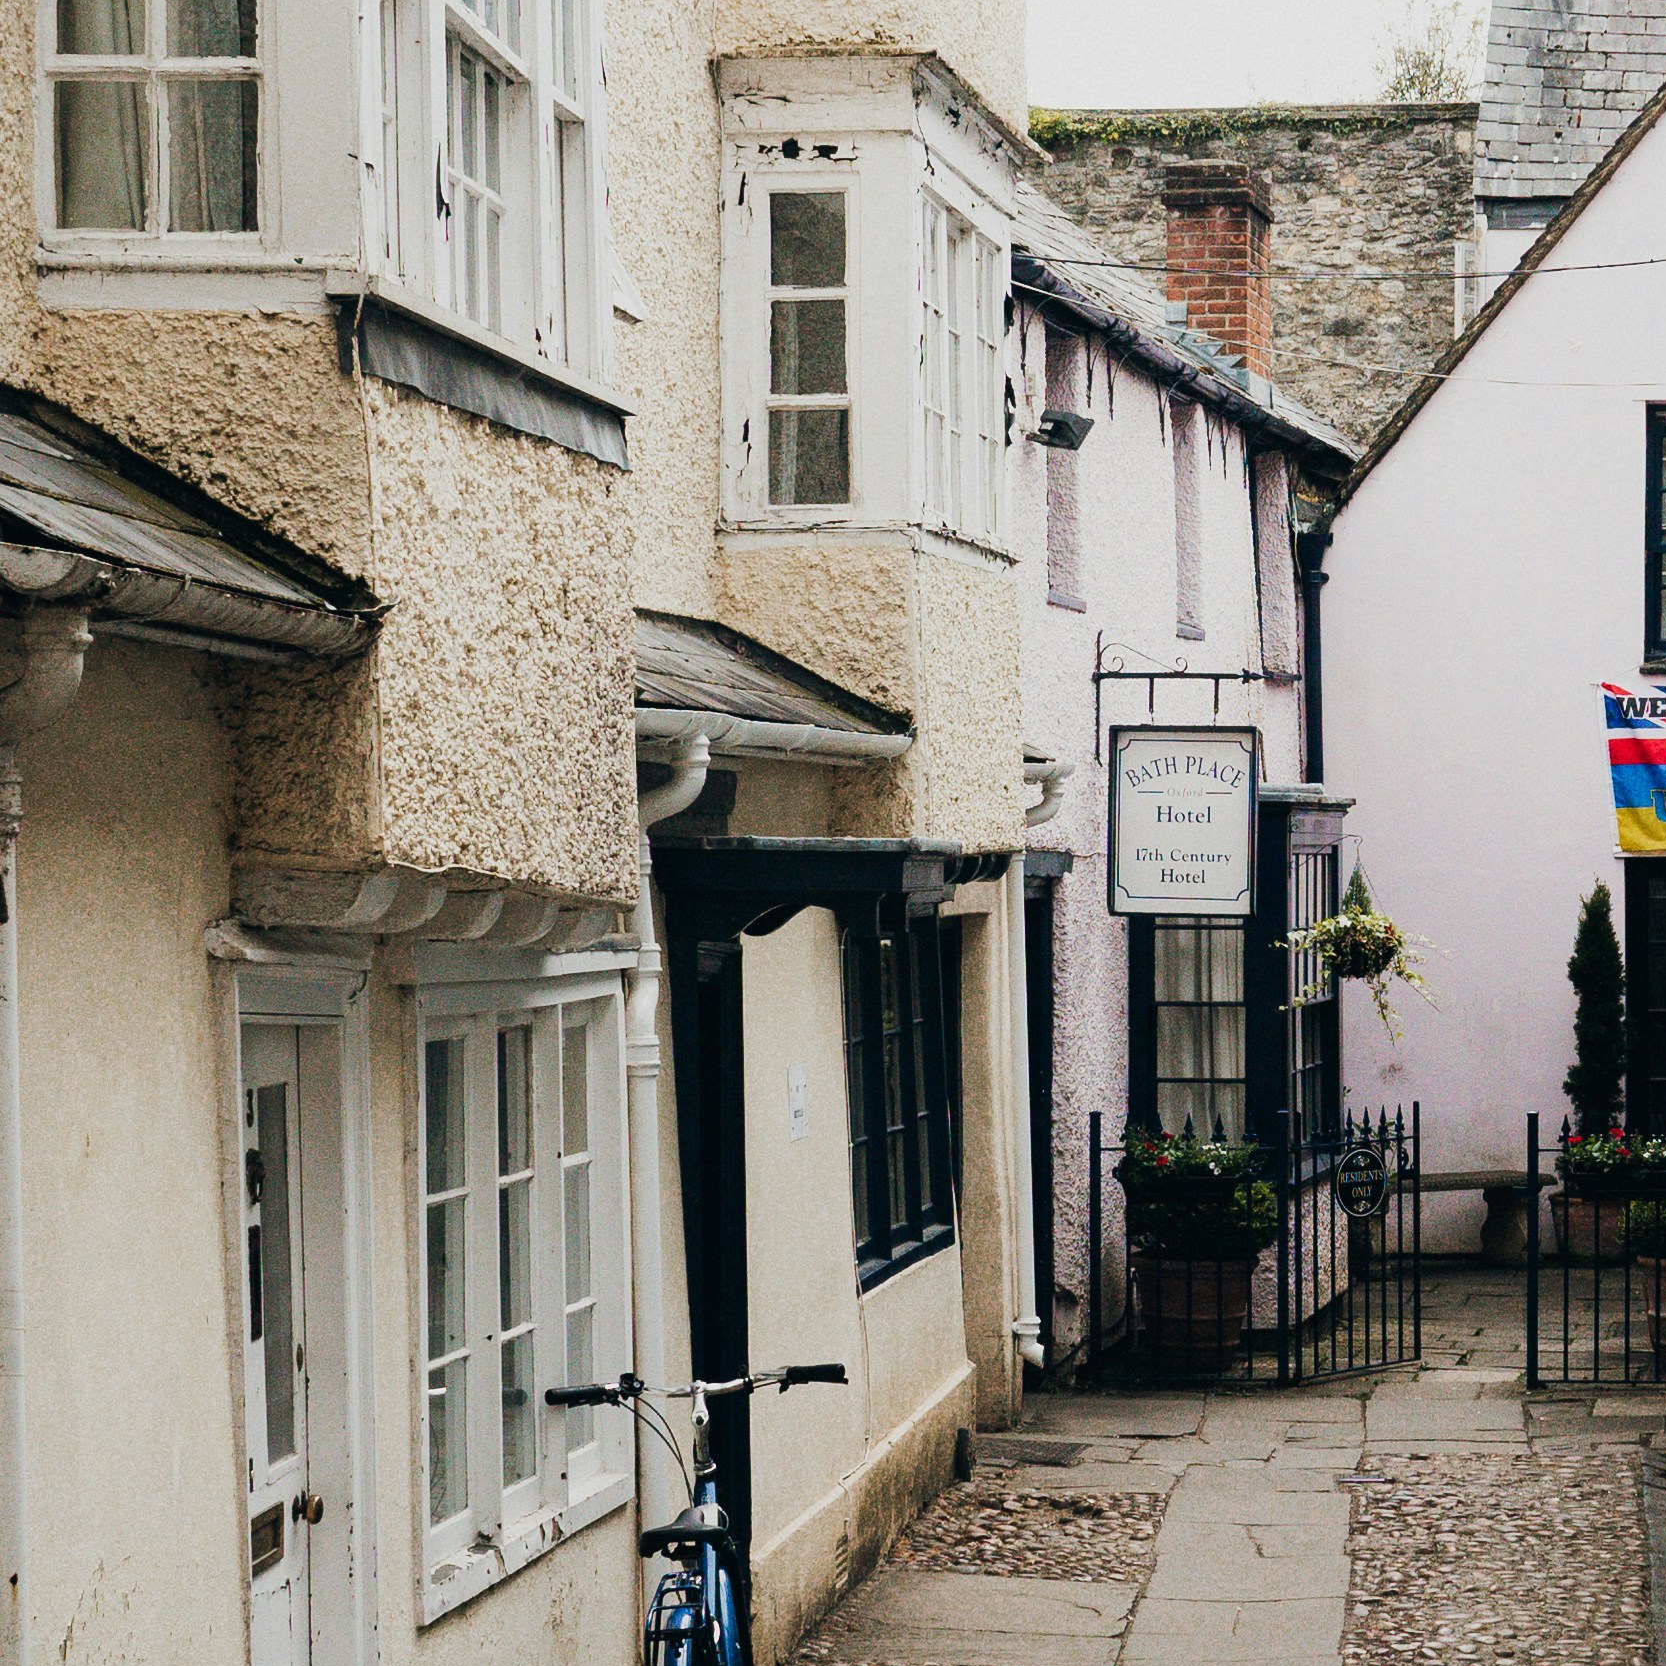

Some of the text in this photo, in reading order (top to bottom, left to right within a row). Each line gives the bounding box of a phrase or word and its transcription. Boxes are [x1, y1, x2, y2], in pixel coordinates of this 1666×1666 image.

[1125, 755, 1246, 789] BATH PLACE
[1167, 787, 1204, 798] Oxford
[1156, 805, 1212, 824] Hotel
[1136, 848, 1232, 866] 17th Century
[1160, 868, 1206, 884] Hotel
[1340, 1170, 1383, 1183] RESIDENTS
[1352, 1186, 1372, 1197] ONLY
